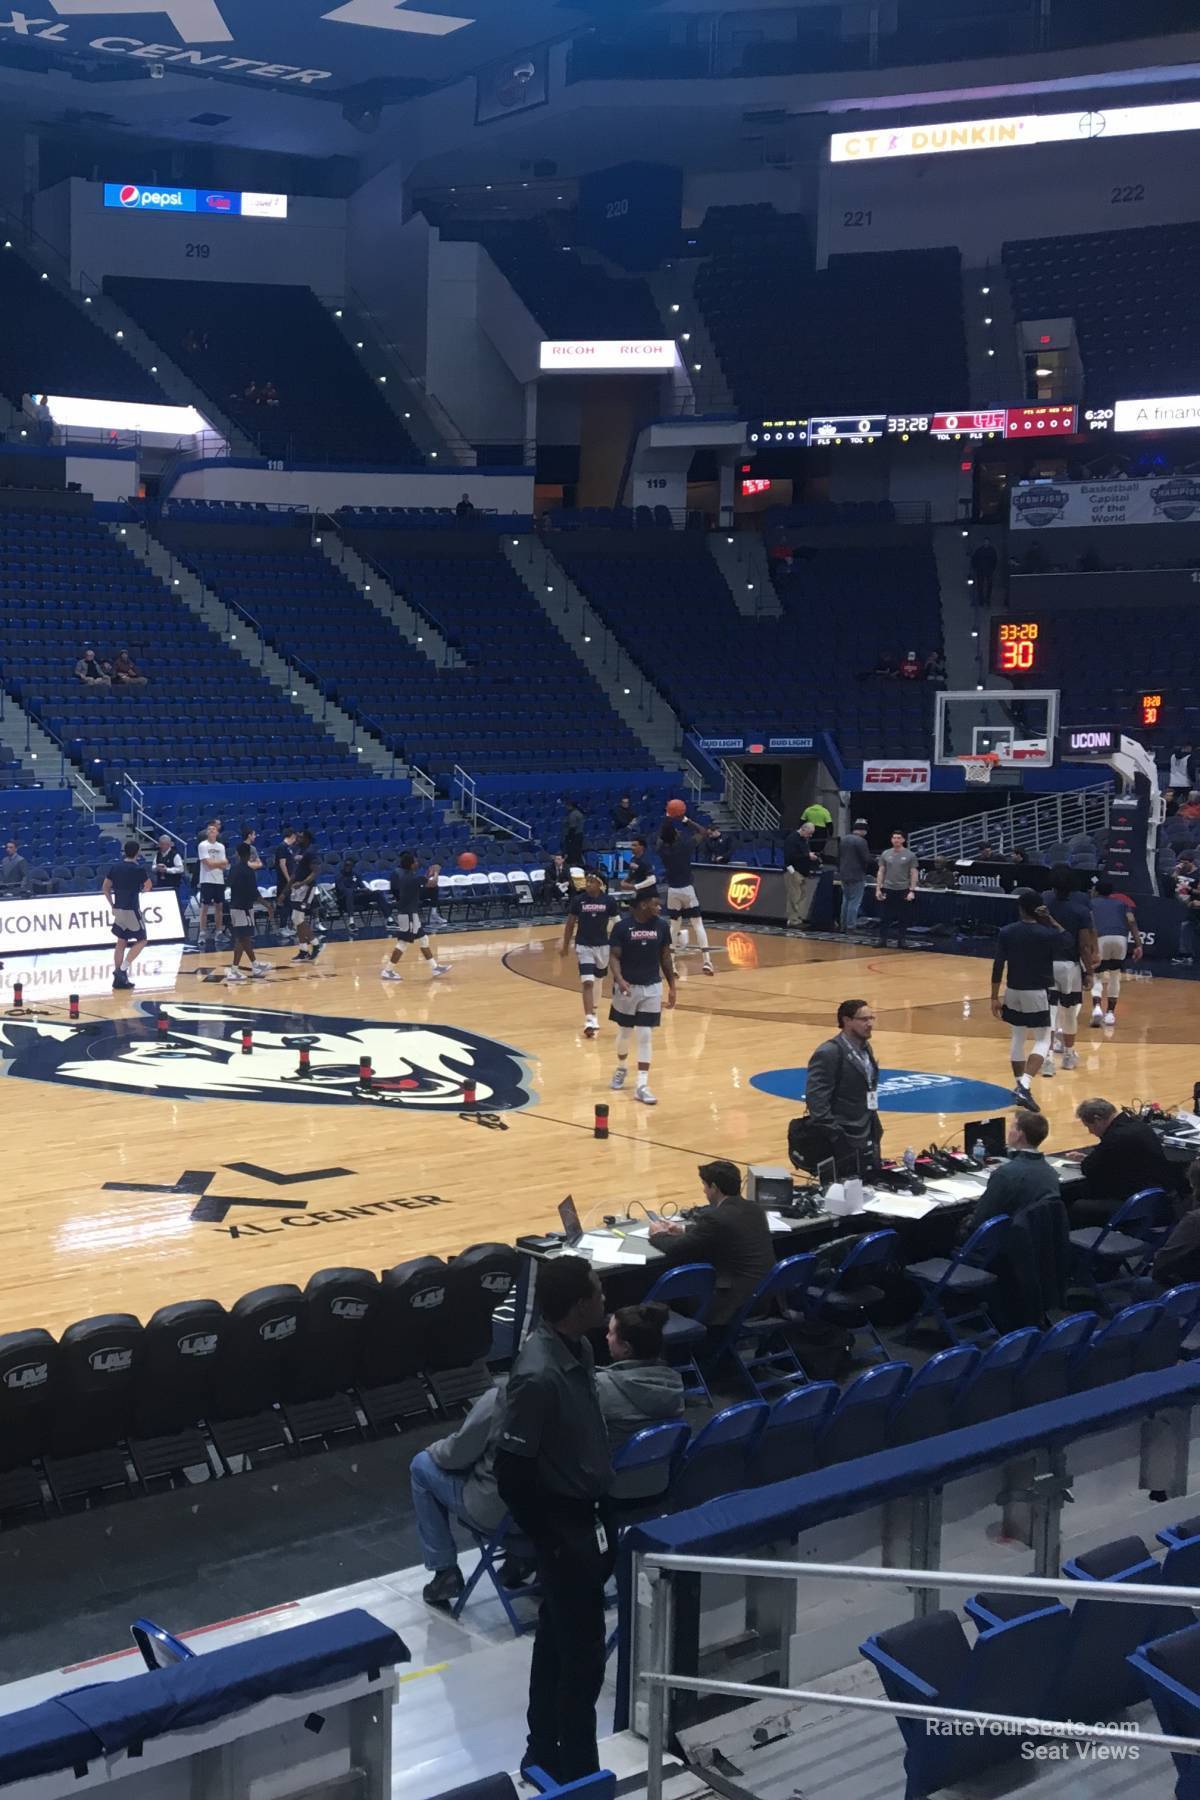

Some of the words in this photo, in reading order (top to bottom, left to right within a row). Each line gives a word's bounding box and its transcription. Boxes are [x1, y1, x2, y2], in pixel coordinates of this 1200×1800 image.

[89, 36, 332, 84] CENTER
[845, 136, 878, 157] CT
[911, 122, 1025, 150] DUNKIN'
[141, 192, 183, 207] pepsi
[1111, 184, 1145, 204] 222
[606, 199, 629, 218] 220
[843, 210, 874, 227] 221
[185, 243, 210, 258] 219
[553, 346, 595, 355] RICOH
[620, 345, 663, 354] RICOH
[1084, 409, 1113, 420] 6:20
[1136, 408, 1149, 421] A
[858, 420, 871, 432] 0
[887, 418, 928, 432] 33:28
[945, 416, 958, 429] 0
[1090, 420, 1107, 430] PM
[268, 460, 284, 471] 118
[646, 479, 667, 488] 119
[1081, 483, 1140, 494] Basketball
[1089, 494, 1130, 505] Capital
[1092, 505, 1108, 513] of
[1108, 504, 1126, 512] the
[1091, 514, 1126, 523] World
[1000, 623, 1038, 640] 33:28
[1003, 641, 1034, 669] 30
[1144, 708, 1157, 723] 30
[771, 739, 787, 747] BUD
[788, 738, 813, 746] LIGHT
[1071, 732, 1110, 748] UCONN
[865, 767, 928, 783] ESPN
[731, 883, 756, 902] ups
[68, 906, 163, 930] ATHLCS
[214, 1224, 284, 1239] XL
[281, 1194, 453, 1227] CENTER
[412, 1287, 445, 1308] LAZ
[332, 1301, 368, 1318] LAZ
[263, 1315, 297, 1341] LAZ
[180, 1333, 218, 1354] LAZ
[93, 1349, 133, 1370] LAZ
[7, 1363, 48, 1388] LAZ
